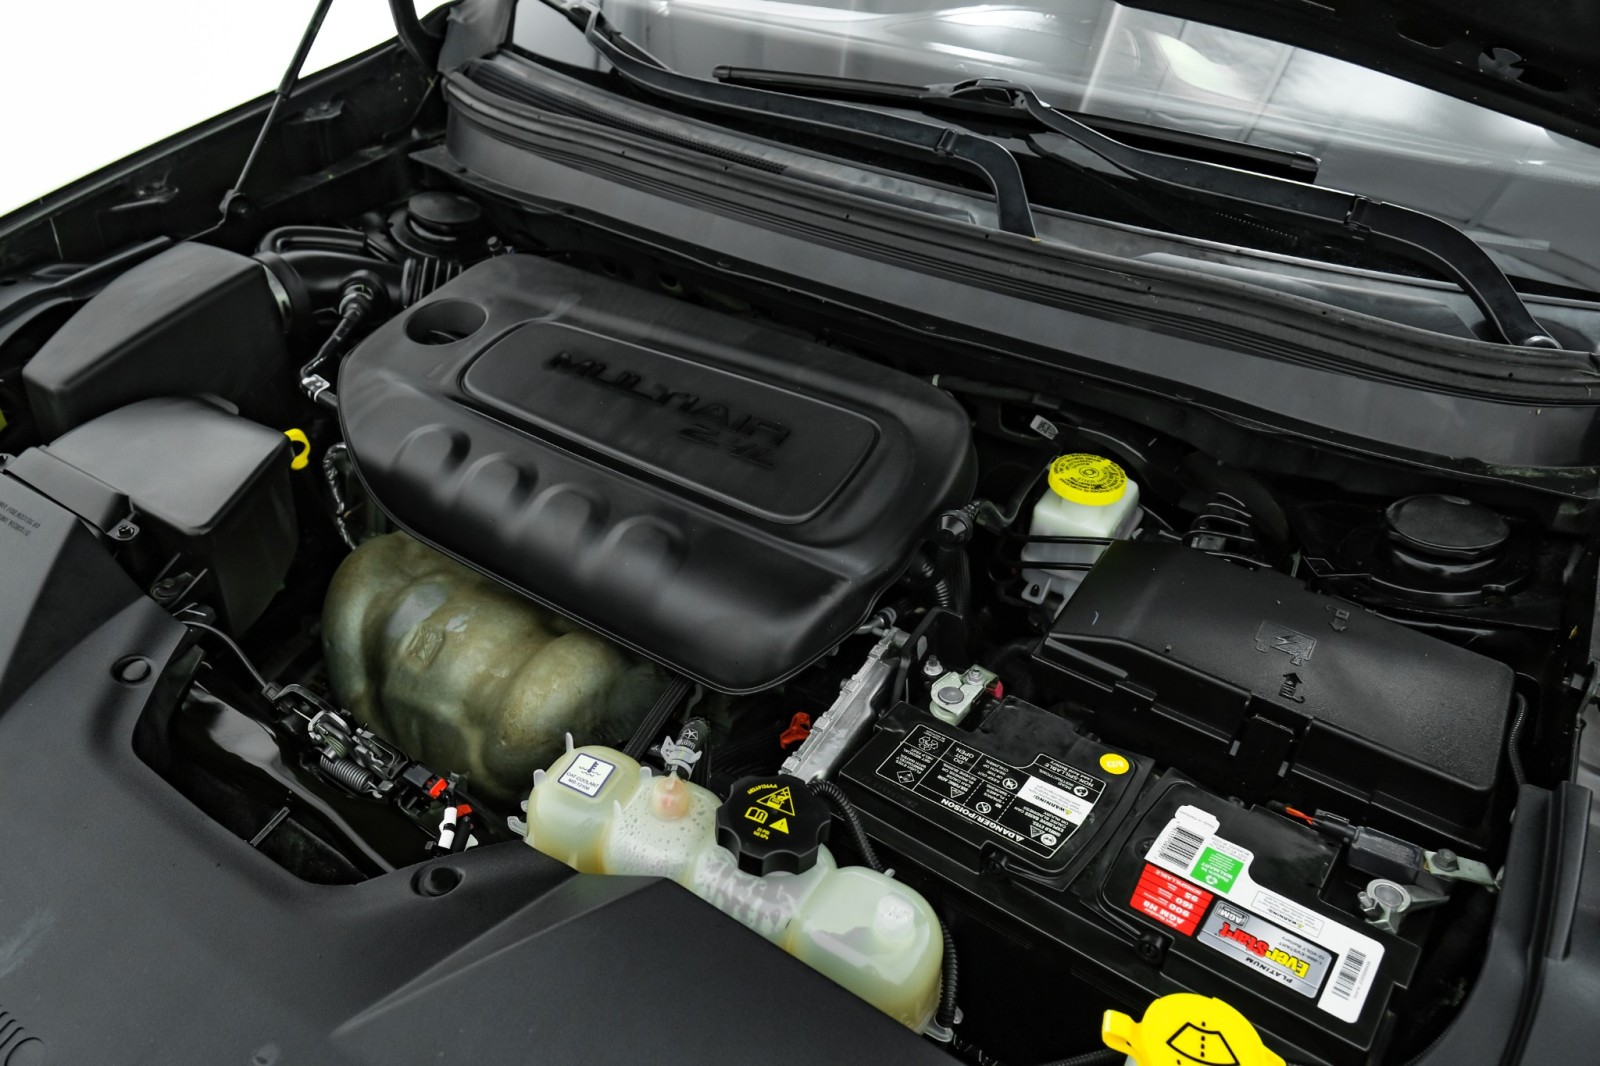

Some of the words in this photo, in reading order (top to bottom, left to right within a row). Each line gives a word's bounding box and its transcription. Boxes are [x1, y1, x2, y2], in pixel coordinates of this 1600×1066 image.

[954, 752, 969, 761] NOT
[940, 798, 1016, 838] DANGER/POISON
[1200, 861, 1233, 879] WALMART
[1183, 891, 1198, 902] 95
[1158, 907, 1184, 925] AGM
[1167, 901, 1190, 918] 900
[1219, 908, 1241, 924] AGM
[1216, 920, 1310, 979] EverStart
[1244, 955, 1292, 983] PLATINUM
